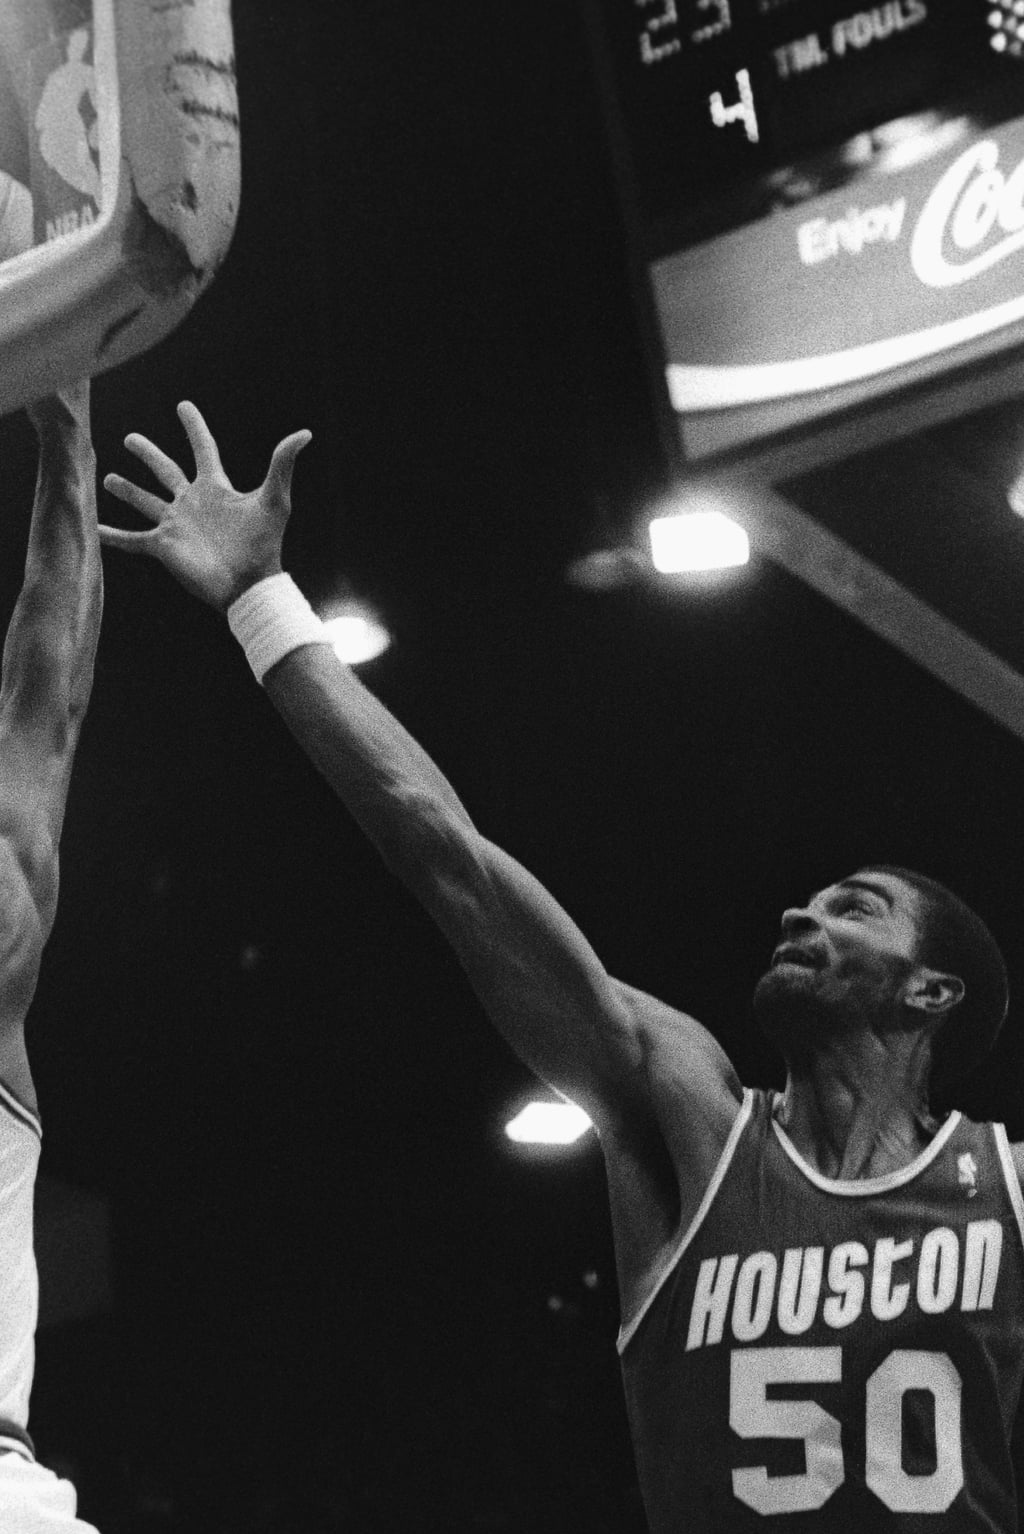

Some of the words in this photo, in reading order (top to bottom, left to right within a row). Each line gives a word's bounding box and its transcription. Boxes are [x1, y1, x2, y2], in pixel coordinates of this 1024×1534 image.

[709, 68, 760, 143] 4
[796, 197, 906, 267] Enjoy
[728, 1345, 965, 1517] 50
